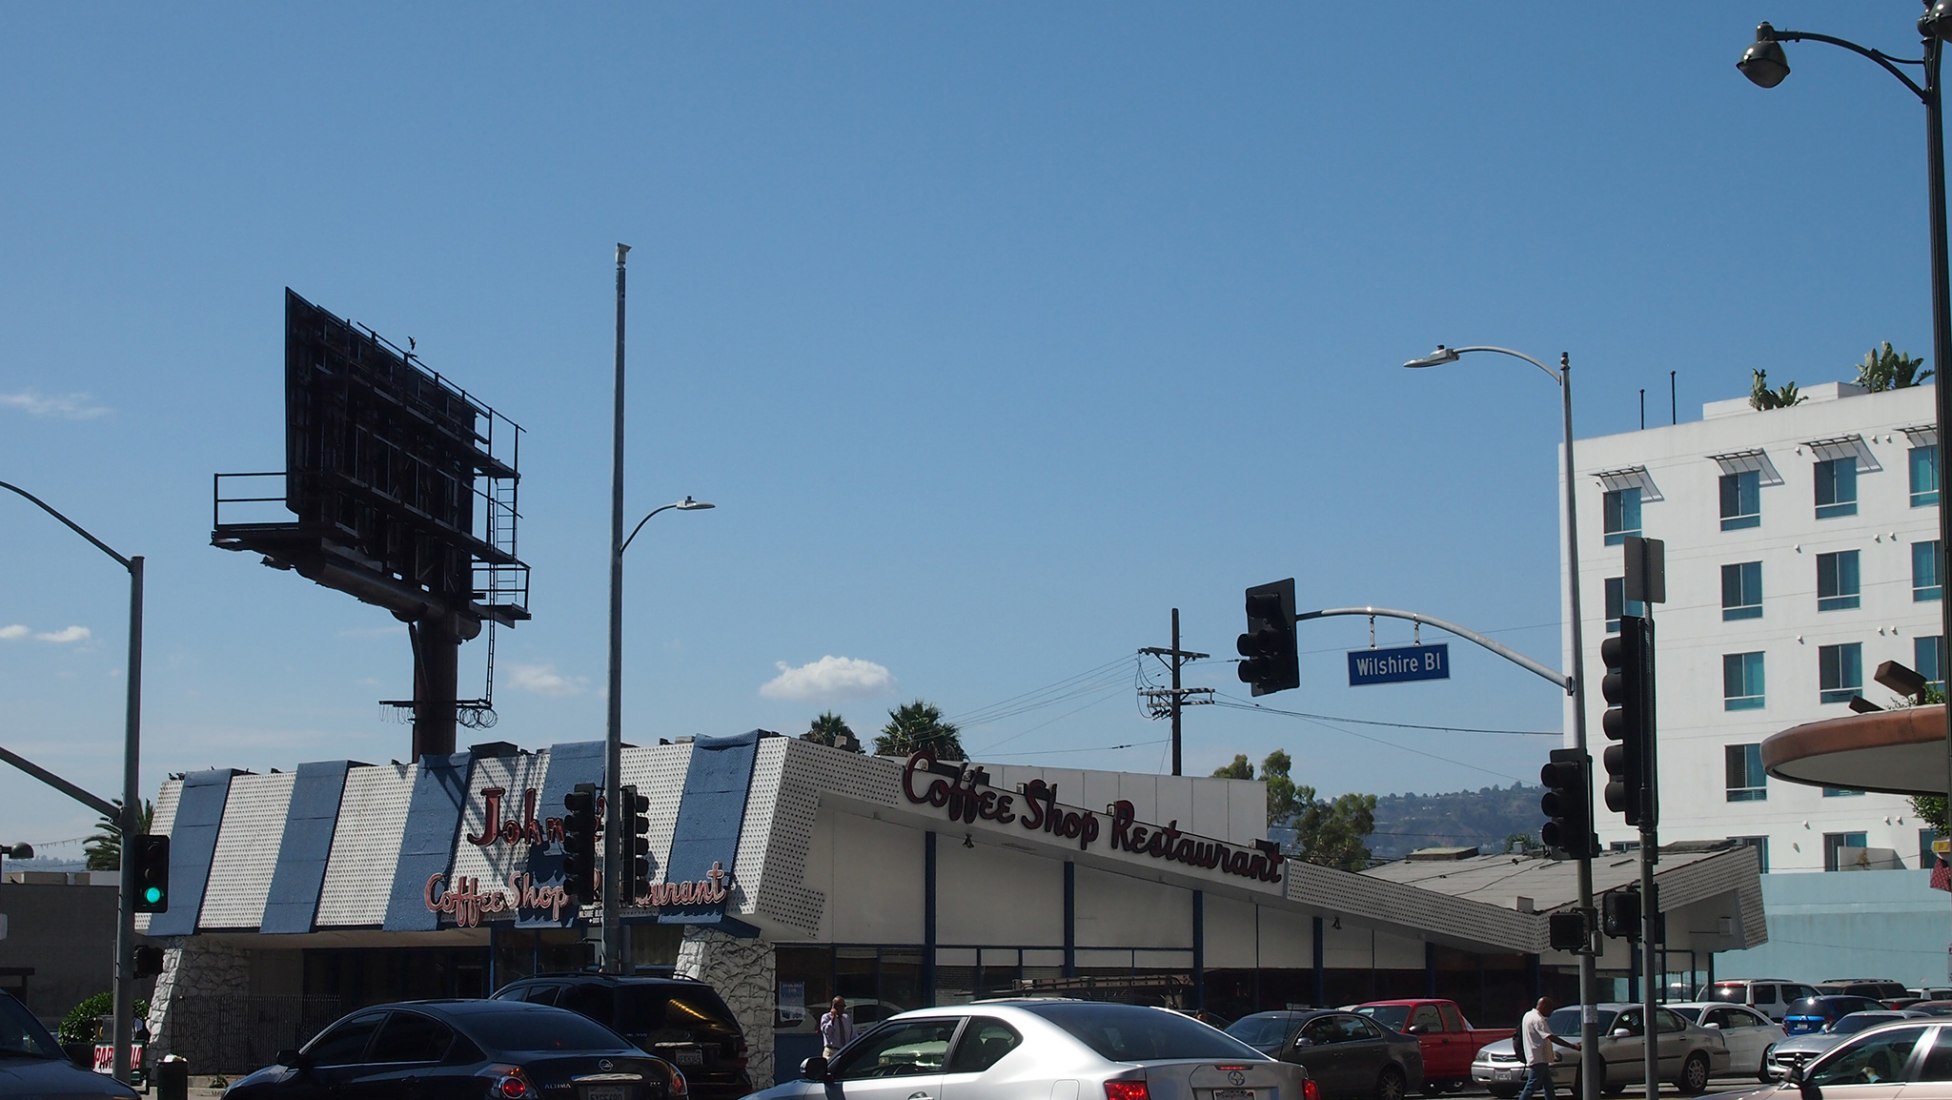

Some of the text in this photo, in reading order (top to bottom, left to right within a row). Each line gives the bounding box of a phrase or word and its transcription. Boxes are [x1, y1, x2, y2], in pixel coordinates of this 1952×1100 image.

[1356, 652, 1441, 677] Wilshire Bl
[903, 750, 1285, 883] Coffee Shop Restaurant
[424, 872, 507, 929] Coffee
[508, 871, 569, 921] Shop
